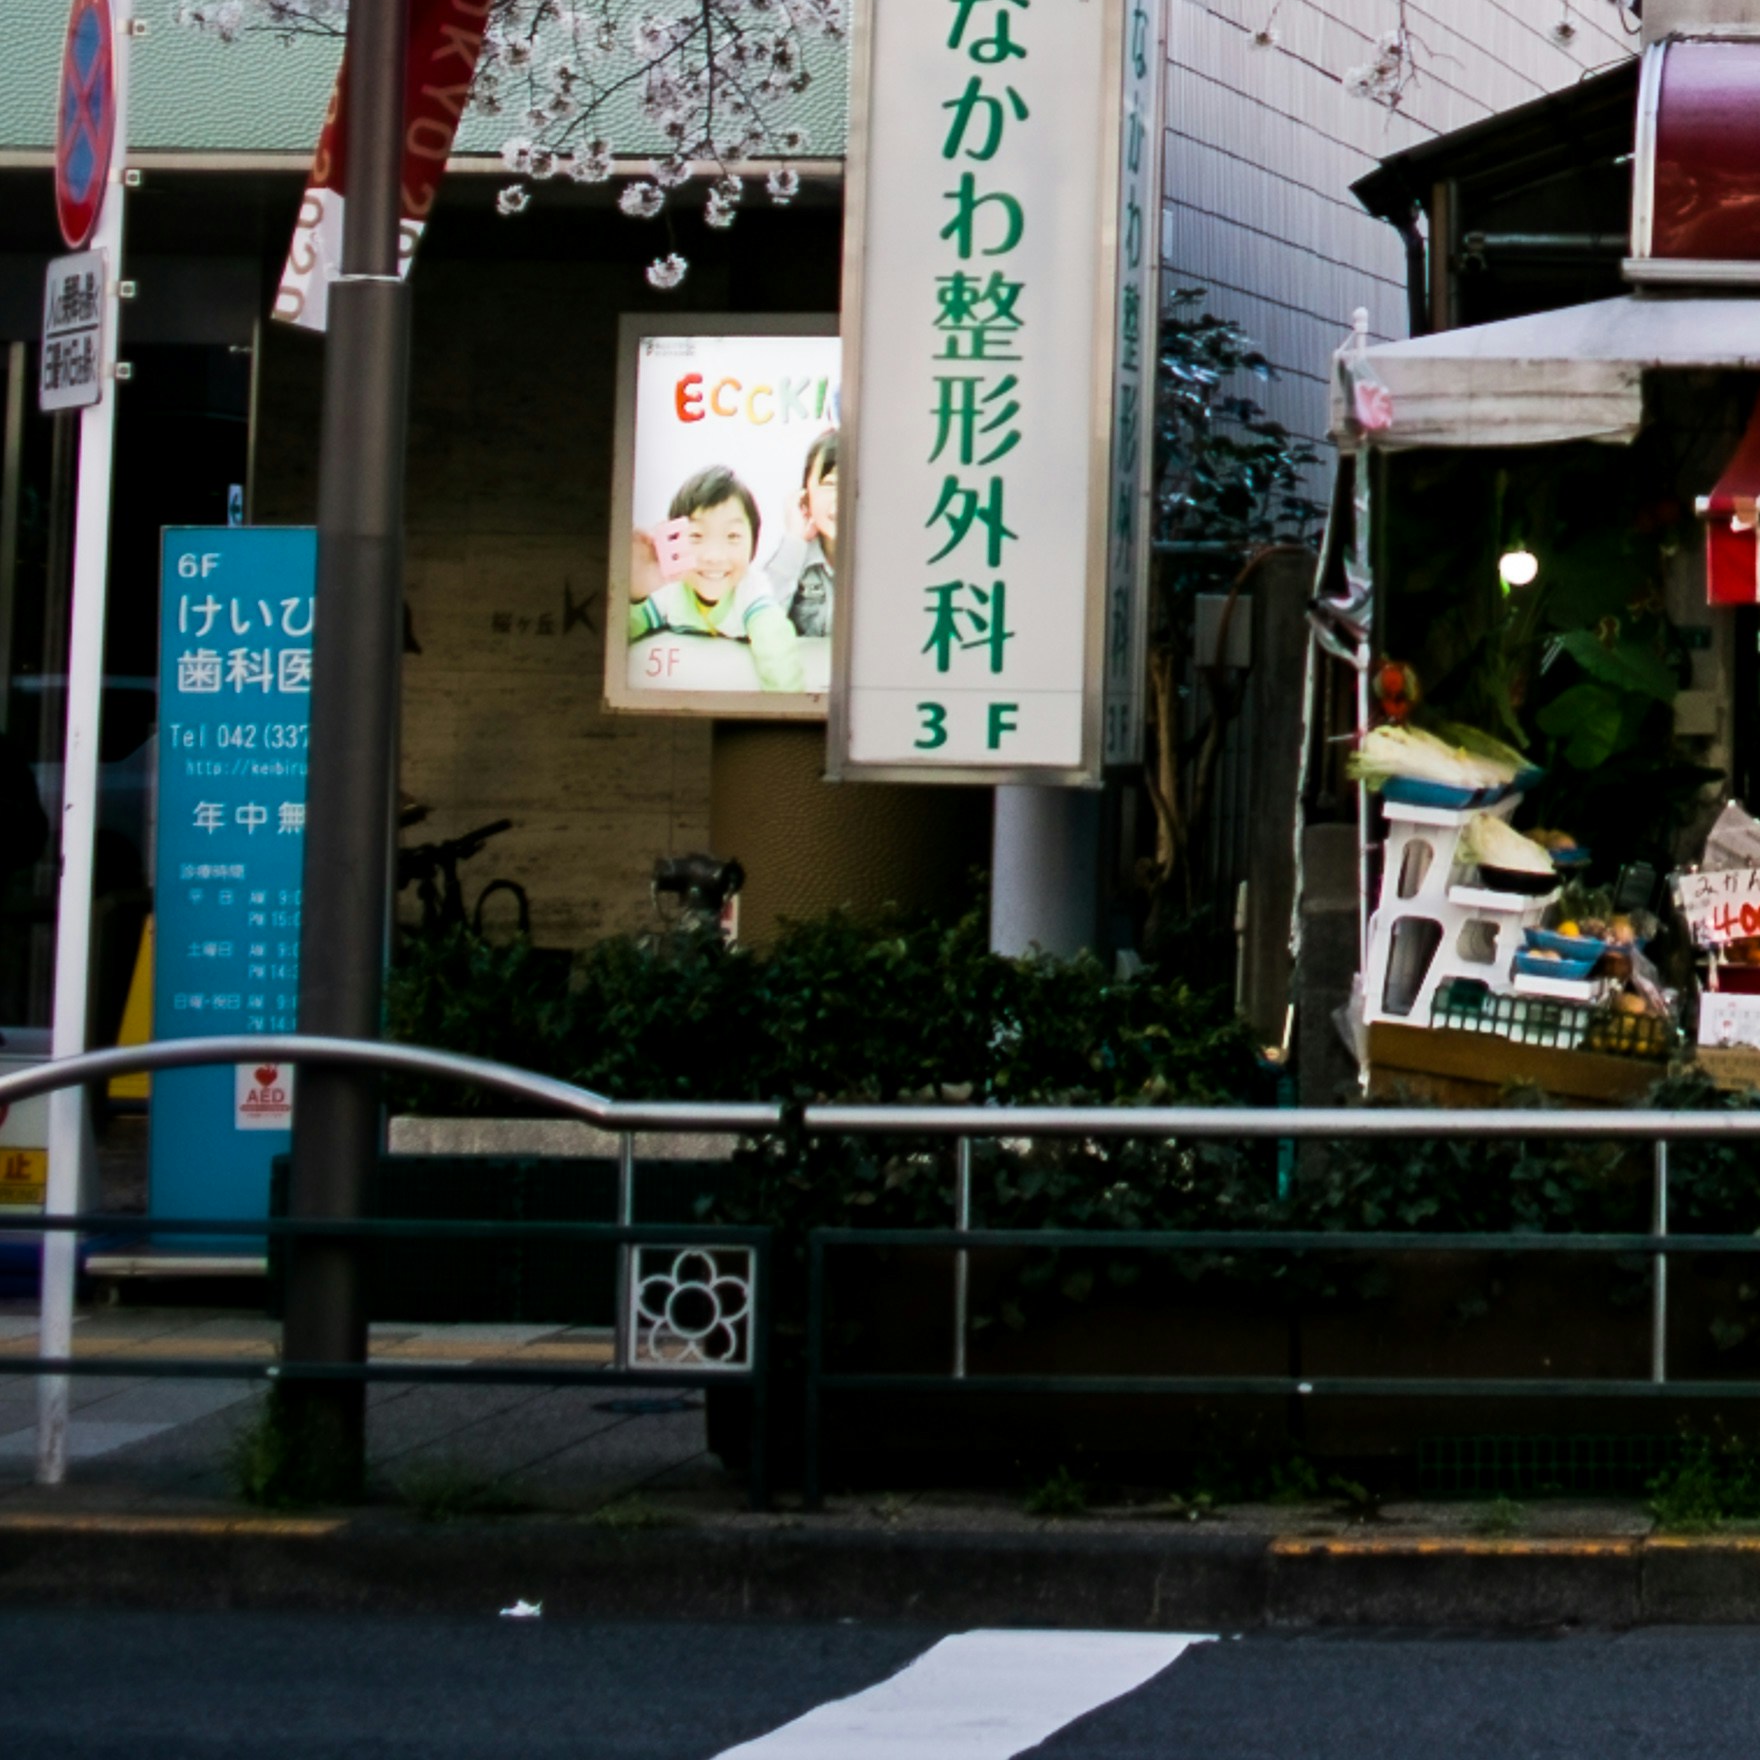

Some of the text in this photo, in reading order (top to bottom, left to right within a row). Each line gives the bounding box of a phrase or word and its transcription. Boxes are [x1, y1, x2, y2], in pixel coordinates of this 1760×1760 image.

[178, 553, 221, 578] 6F
[177, 647, 312, 694] 歯科医
[645, 648, 681, 678] 5F
[246, 1089, 285, 1103] AED
